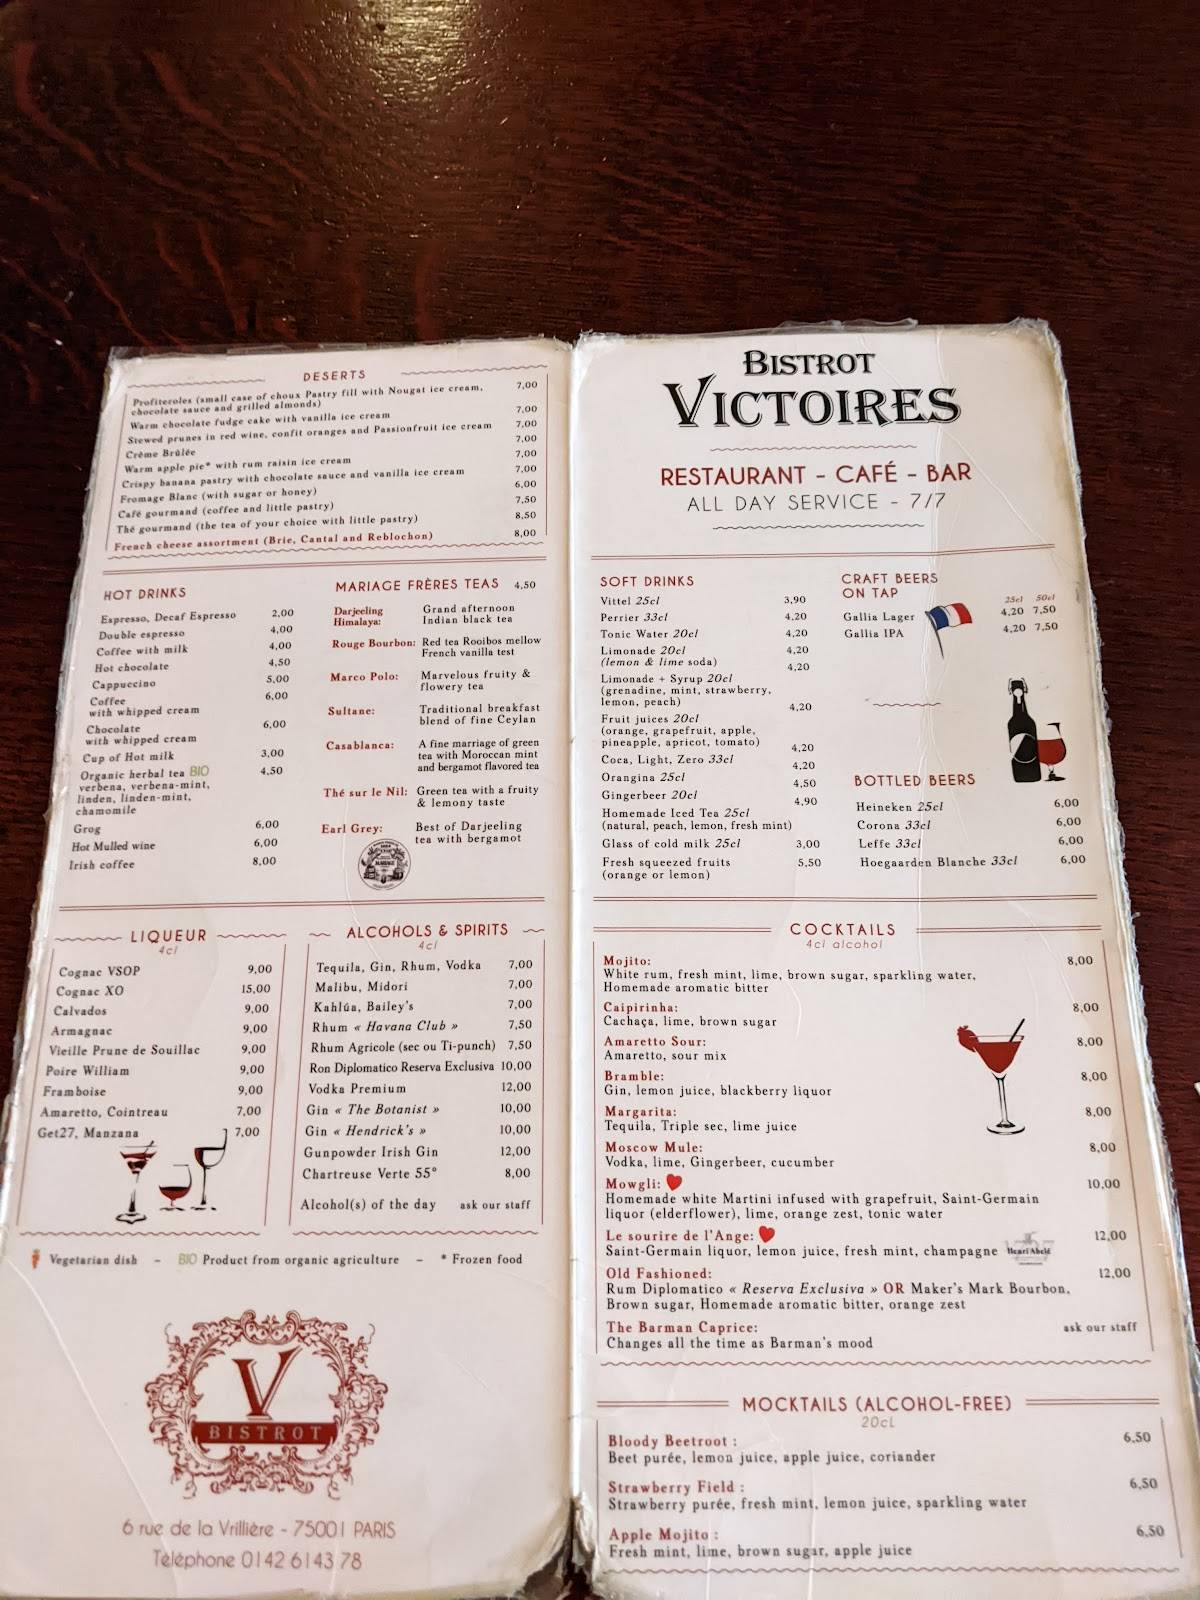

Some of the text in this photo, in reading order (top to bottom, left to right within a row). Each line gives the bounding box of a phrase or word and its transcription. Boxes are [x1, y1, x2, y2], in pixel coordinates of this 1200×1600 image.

[303, 369, 365, 382] DESERTS
[516, 380, 538, 390] 7,00
[130, 412, 390, 430] Warm chocolate fudge cake with vanilla ice cream
[661, 465, 806, 486] RESTAURANT
[835, 460, 897, 483] CAFÉ
[926, 462, 972, 482] BAR
[687, 495, 723, 512] ALL
[735, 495, 776, 511] DAY
[788, 493, 878, 510] SERVICE
[910, 491, 946, 509] 7/7
[114, 530, 432, 551] French cheese assortment (Brie, Cantal and Reblochon)
[335, 577, 498, 592] MARIAGE FRÈRES TEAS
[599, 575, 694, 587] SOFT DRINKS
[841, 572, 938, 584] CRAFT BEERS
[514, 580, 536, 590] 4,50
[103, 587, 186, 600] HOT DRINKS
[600, 595, 660, 605] Vittel 25cl
[784, 595, 806, 604] 3,90
[100, 611, 236, 625] Espresso, Decaf Espresso
[271, 608, 294, 617] 2,00
[844, 628, 904, 638] Gallia IPA
[1002, 621, 1058, 633] 4,20 7,50
[331, 638, 415, 650] Rouge Bourbon:
[422, 635, 541, 646] Red tea Rooibos mellow
[327, 706, 375, 716] Sultane:
[419, 702, 540, 714] Traditional breakfast
[80, 770, 124, 782] Organic
[128, 767, 164, 779] herbal
[168, 769, 185, 777] tea
[260, 766, 283, 775] 4,50
[854, 773, 975, 786] BOTTLED BEERS
[321, 823, 382, 835] Earl Grey:
[68, 859, 135, 870] Irish coffee
[602, 856, 730, 869] Fresh squeezed fruits
[797, 858, 821, 868] 5,50
[860, 855, 1018, 869] Hoegaarden Blanche 33cl
[1060, 854, 1086, 864] 6,00
[346, 922, 508, 938] ALCOHOLS & SPIRITS
[790, 922, 895, 936] COCKTAILS
[130, 928, 206, 944] LIQUEUR
[316, 959, 481, 975] Tequila, Gin, Rhum, Vodka
[508, 959, 533, 970] 7,00
[603, 955, 650, 968] Mojito:
[1067, 955, 1093, 966] 8,00
[58, 965, 140, 979] Cognac VSOP
[247, 964, 272, 974] 9,00
[603, 1001, 677, 1014] Caipirinha:
[603, 1014, 776, 1029] Cachaça, lime, brown sugar
[311, 1039, 495, 1055] Rhum Agricole (sec ou Ti-punch)
[508, 1039, 532, 1050] 7,50
[83, 1126, 139, 1138] Manzana
[303, 1145, 438, 1160] Gunpowder Irish Gin
[500, 1145, 531, 1157] 12,00
[605, 1141, 702, 1152] Moscow Mule:
[1088, 1142, 1116, 1153] 8,00
[604, 1155, 834, 1170] Vodka, lime, Gingerbeer, cucumber
[49, 1253, 137, 1267] Vegetarian dish
[606, 1266, 711, 1279] Old Fashioned:
[1098, 1266, 1131, 1279] 12,00
[742, 1395, 1011, 1412] MOCKTAILS (ALCOHOL-FREE)
[208, 1424, 321, 1440] BISTROT
[1123, 1431, 1151, 1443] 6,50
[607, 1433, 658, 1450] Bloody
[665, 1433, 727, 1447] Beetroot
[608, 1495, 1026, 1513] Strawberry purée, fresh mint, lemon juice, sparkling water
[121, 1518, 134, 1536] 6
[138, 1523, 163, 1536] rue
[169, 1519, 191, 1536] de
[197, 1519, 213, 1536] la
[218, 1519, 274, 1537] Vrillière
[353, 1520, 396, 1539] PARIS
